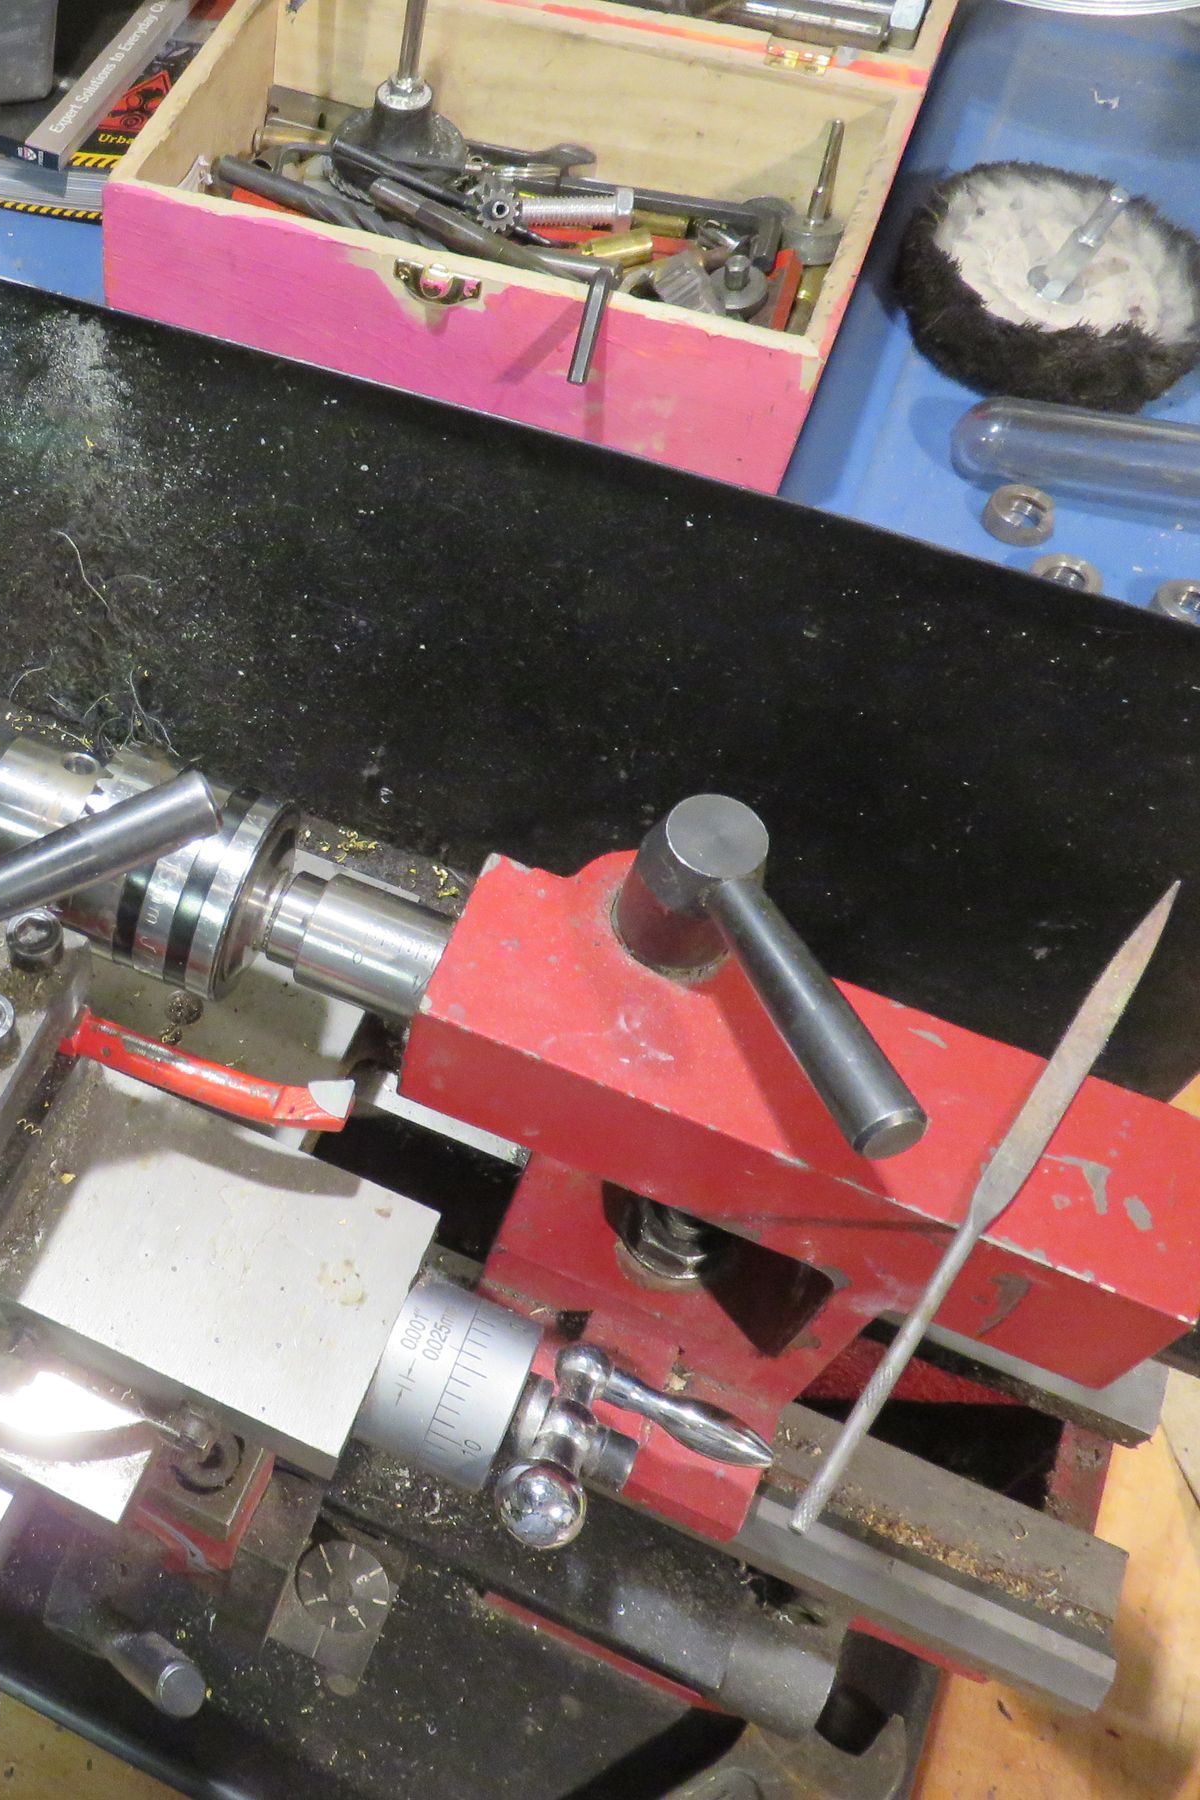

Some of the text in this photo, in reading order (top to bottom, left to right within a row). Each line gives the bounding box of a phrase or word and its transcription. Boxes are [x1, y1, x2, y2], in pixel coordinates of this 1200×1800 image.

[49, 103, 83, 133] Expert
[75, 63, 117, 103] Solutions
[109, 51, 125, 62] to
[118, 10, 159, 52] Everyday
[98, 133, 136, 145] Urba
[462, 1438, 482, 1457] 10
[347, 1605, 359, 1617] 5
